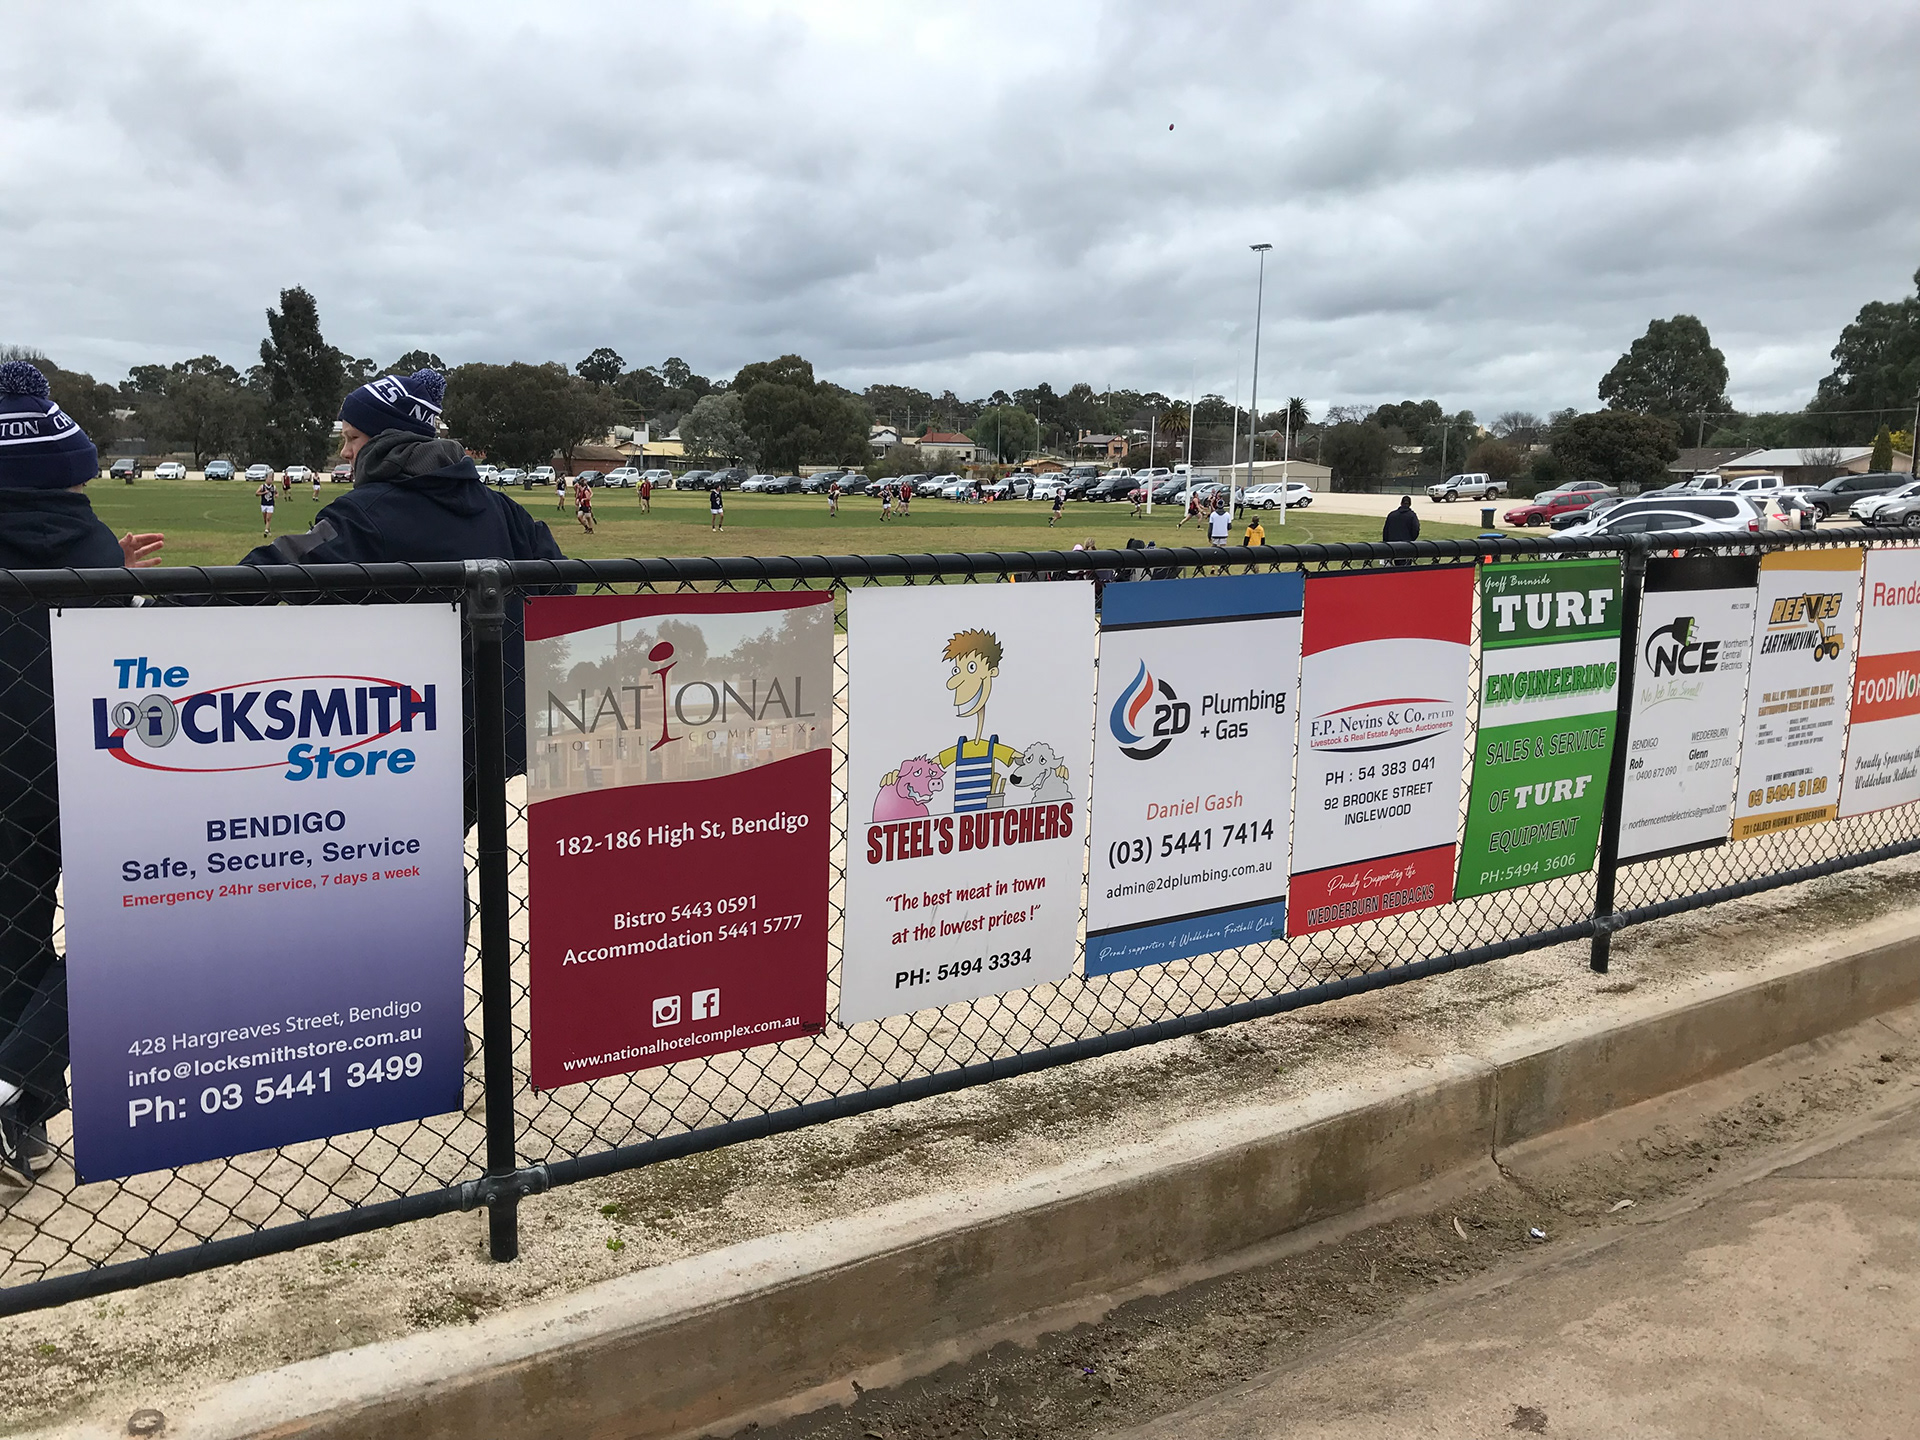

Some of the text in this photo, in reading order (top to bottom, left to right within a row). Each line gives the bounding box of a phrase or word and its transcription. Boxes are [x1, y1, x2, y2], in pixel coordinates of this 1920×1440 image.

[1485, 574, 1551, 593] Geoff Burnside
[1492, 589, 1614, 632] TURF
[1768, 592, 1842, 625] REEVES
[1722, 649, 1742, 660] Central
[1723, 639, 1748, 648] Northern
[1760, 630, 1819, 654] EARTHMOVING
[114, 657, 190, 688] The
[1654, 641, 1721, 677] NCE
[1720, 660, 1742, 671] Electrics
[1484, 662, 1617, 707] ENGINEERING
[1202, 689, 1286, 716] Plumbing
[1153, 702, 1190, 737] 2D
[1216, 720, 1248, 740] Gas
[1310, 721, 1453, 748] Livestock & Real Estate Agents, Auctioneers
[1311, 708, 1454, 738] F.P. Nevins & Co. PTY LTD
[1692, 728, 1729, 741] WEDDERBURN
[548, 736, 645, 753] HOTEL
[1486, 727, 1607, 766] SALES & SERVICE
[1632, 738, 1658, 750] BENDIGO
[1689, 748, 1708, 760] Glenn
[285, 743, 416, 781] Store
[1326, 770, 1344, 786] PH
[1358, 766, 1376, 780] 54
[1381, 761, 1406, 777] 383
[1412, 756, 1436, 771] 041
[1630, 757, 1644, 770] Rob
[1855, 754, 1882, 772] Proudly
[1147, 790, 1243, 820] Daniel Gash
[1324, 782, 1433, 810] 92 BROOKE STREET
[1488, 774, 1592, 813] OF TURF
[1748, 776, 1828, 808] 03 5494 3120
[206, 810, 346, 842] BENDIGO
[1344, 803, 1411, 826] INGLEWOOD
[1753, 819, 1772, 832] CALDER
[1796, 808, 1827, 824] WEDDERBURN
[556, 812, 809, 856] 182-186 High St, Bendigo
[867, 802, 1073, 864] STEEL'S BUTCHERS
[1109, 818, 1273, 869] (03) 5441 7414
[1488, 816, 1580, 854] EQUIPMENT
[122, 837, 420, 882] Safe, Secure, Service
[1480, 853, 1576, 885] PH:5494 3606
[123, 865, 420, 908] Emergency 24hr service, 7 days a week
[923, 889, 952, 906] best
[956, 883, 992, 901] meat
[996, 880, 1008, 894] in
[1012, 876, 1046, 893] town
[1106, 862, 1272, 898] admin@2dplumbing.com.au
[1327, 862, 1416, 896] Proudly Supporting the
[614, 895, 757, 930] Bistro 5443 0591
[1307, 883, 1435, 927] WEDDERBURN REDBACKS
[563, 914, 802, 966] Accommodation 5441 5777
[892, 928, 909, 944] at
[913, 922, 936, 940] the
[940, 916, 985, 936] lowest
[988, 910, 1026, 931] prices
[1100, 946, 1126, 962] Proud
[1128, 939, 1165, 956] supporters
[1168, 936, 1178, 948] of
[1180, 926, 1220, 947] Wedderburn
[1224, 920, 1253, 938] Football
[1256, 916, 1274, 932] Club
[896, 948, 1032, 988] PH: 5494 3334
[128, 1000, 422, 1057] 428 Hargreaves Street, Bendigo
[563, 1016, 800, 1071] www.nationalhotelcomplex.com.au
[128, 1027, 422, 1087] info@locksmithstore.com.au
[129, 1052, 423, 1128] Ph: 03 5441 3499
